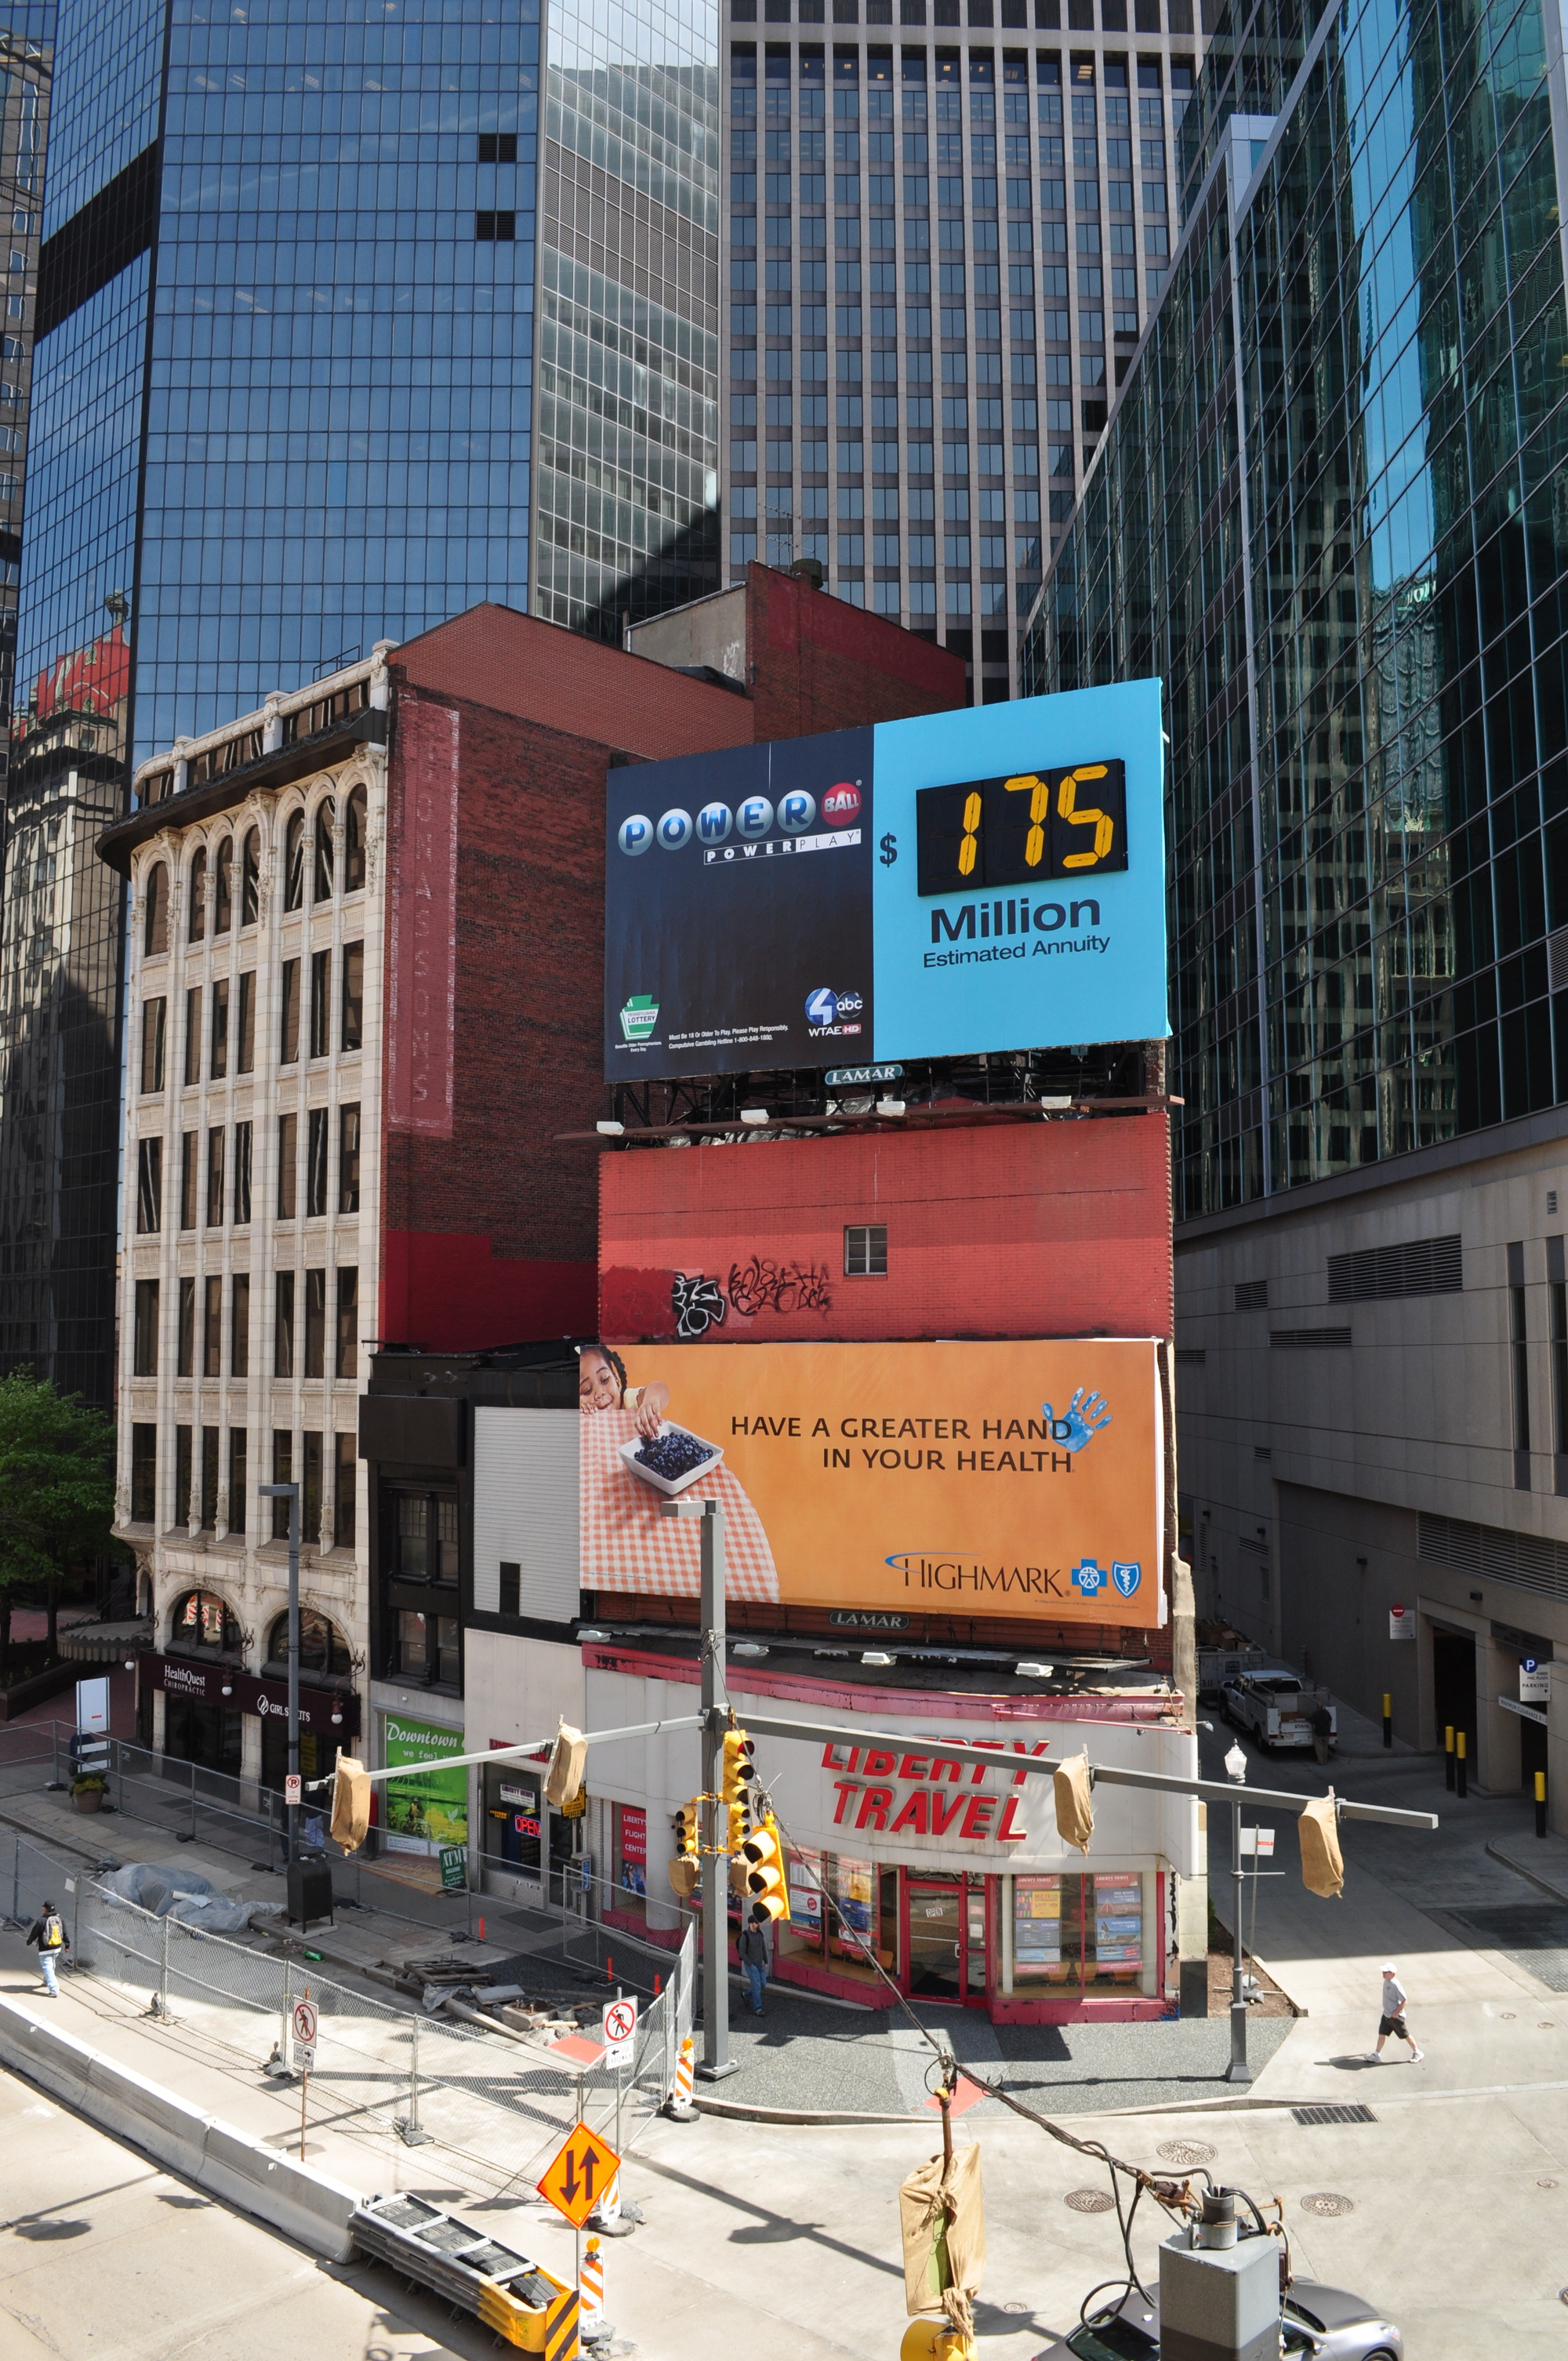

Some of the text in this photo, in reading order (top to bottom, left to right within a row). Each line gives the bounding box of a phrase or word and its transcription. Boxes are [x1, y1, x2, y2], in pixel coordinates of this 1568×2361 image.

[880, 765, 1114, 876] $ 175
[707, 832, 855, 863] POWER PLAY
[931, 897, 1100, 943] Million
[923, 935, 1111, 968] Estimated Annuity
[836, 997, 862, 1012] abc
[627, 1015, 656, 1024] LOTTERY
[808, 1025, 861, 1037] WTAE HD
[669, 1041, 695, 1050] Compulsive
[695, 1038, 717, 1047] Gambling
[832, 1067, 895, 1083] LAMAR
[731, 1416, 1073, 1441] HAVE A GREATER HAND
[823, 1448, 1072, 1473] IN YOUR HEALTH
[904, 1557, 1064, 1597] HIGHMARK
[837, 1613, 902, 1628] LAMAR
[1526, 1659, 1535, 1671] P
[164, 1665, 205, 1687] HealthQuest
[164, 1678, 206, 1696] CHIROPRACTIC
[270, 1703, 284, 1716] GIRL
[387, 1722, 458, 1748] Downtown
[419, 1750, 437, 1760] feel
[821, 1737, 1051, 1786] LIBERTY
[833, 1781, 1028, 1841] TRAVEL
[515, 1816, 541, 1837] OPEN
[625, 1829, 645, 1840] FLIGHT
[442, 1849, 463, 1868] ATM
[927, 1908, 942, 1916] OPEN
